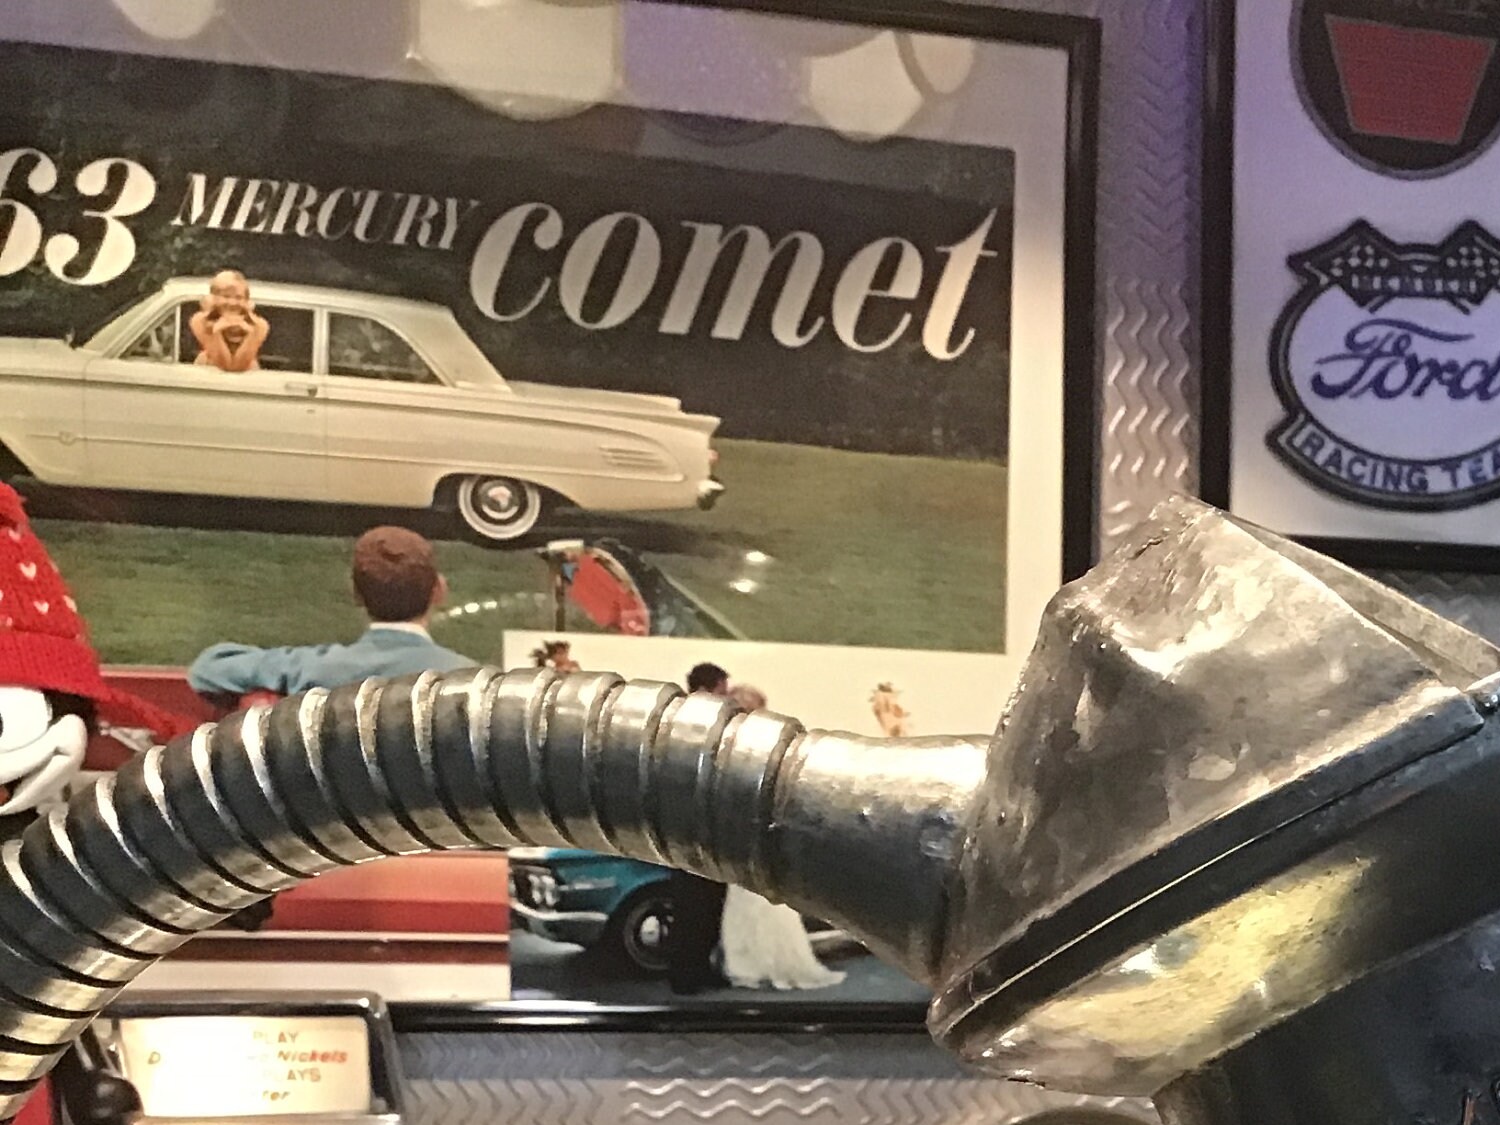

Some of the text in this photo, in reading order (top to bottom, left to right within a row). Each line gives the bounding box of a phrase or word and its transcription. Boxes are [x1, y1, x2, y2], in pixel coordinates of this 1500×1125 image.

[0, 147, 998, 363] 63 MERCURY comet
[1299, 432, 1431, 494] RACING
[277, 1049, 348, 1064] Nickels
